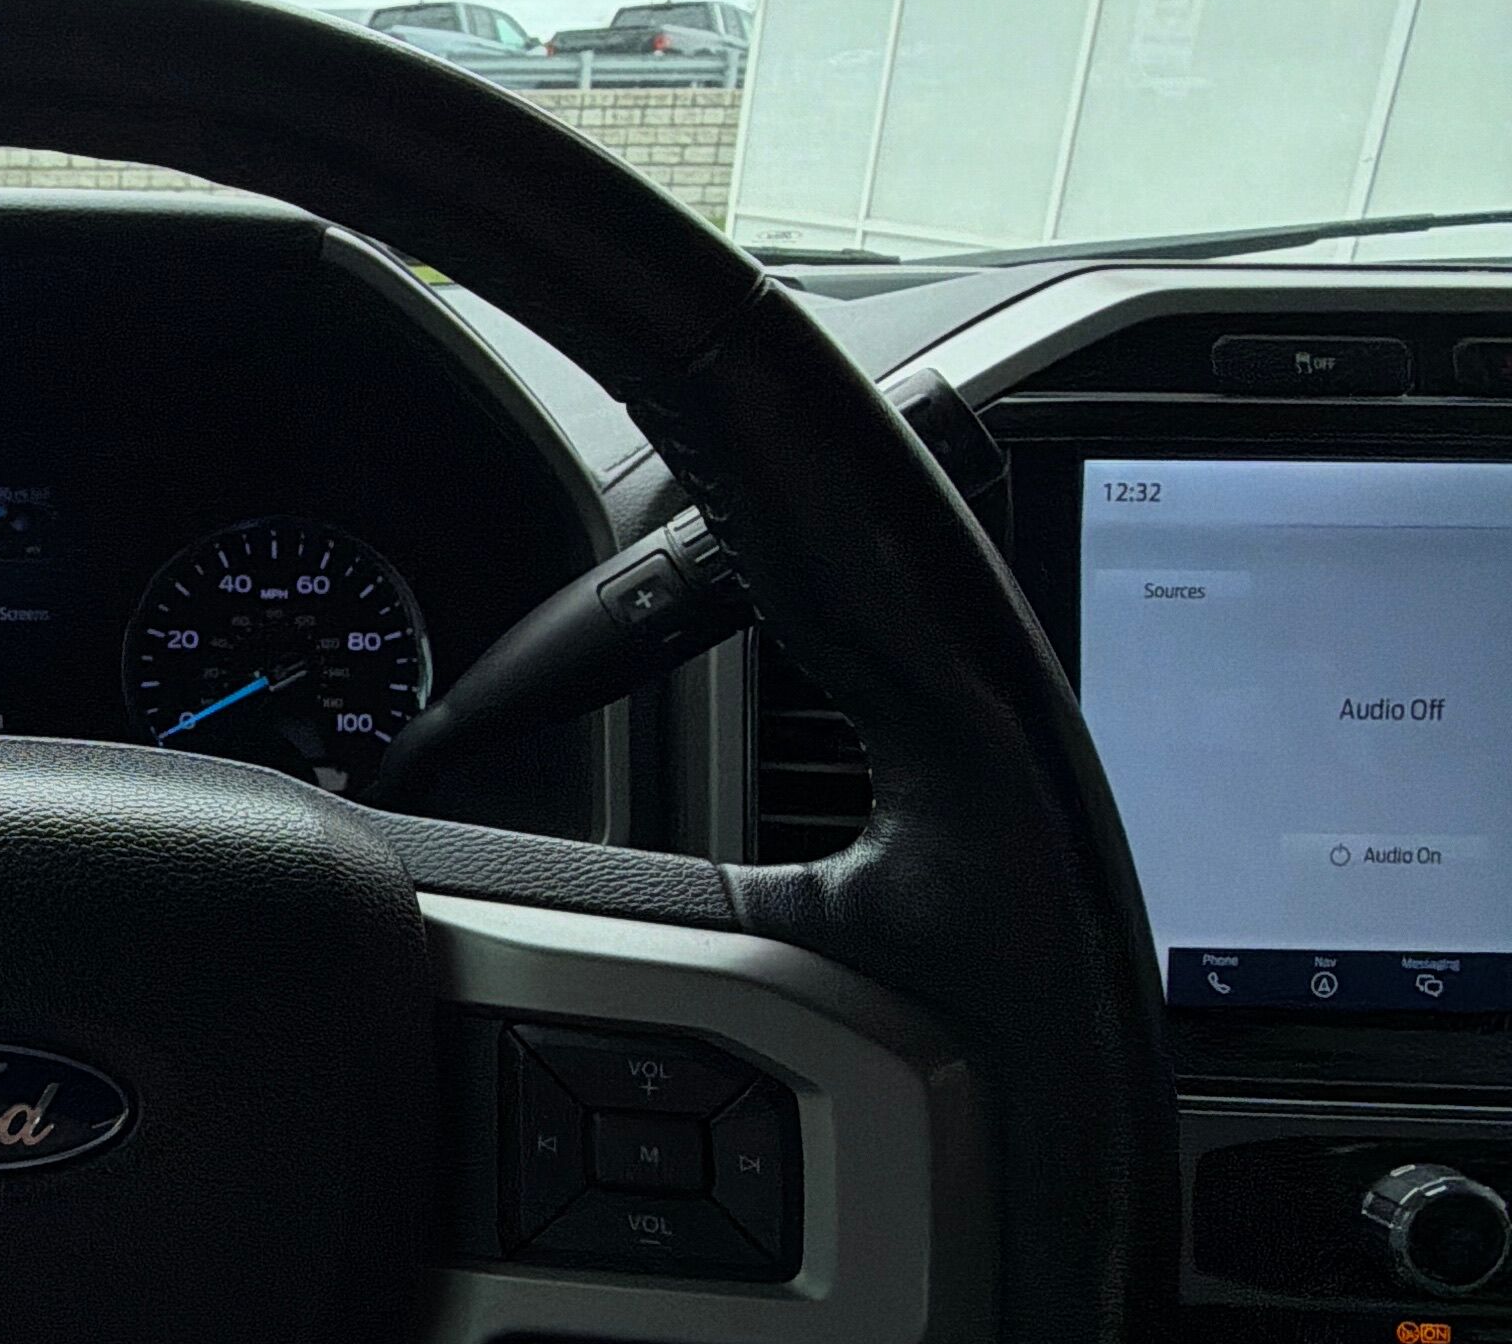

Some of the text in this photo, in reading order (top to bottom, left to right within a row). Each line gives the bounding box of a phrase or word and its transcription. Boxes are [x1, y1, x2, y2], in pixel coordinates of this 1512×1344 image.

[1103, 482, 1162, 503] 12:32
[219, 575, 252, 593] 40
[296, 576, 330, 594] 60
[1144, 583, 1206, 599] Sources
[260, 588, 288, 600] MPH
[167, 630, 199, 649] 20
[347, 632, 381, 651] 80
[1339, 698, 1446, 722] Audio Off
[337, 713, 372, 732] 100
[1363, 846, 1442, 865] Audio On
[1202, 954, 1239, 967] Phone
[1314, 956, 1337, 968] Nav
[628, 1059, 671, 1079] VOL
[628, 1214, 673, 1236] VOL
